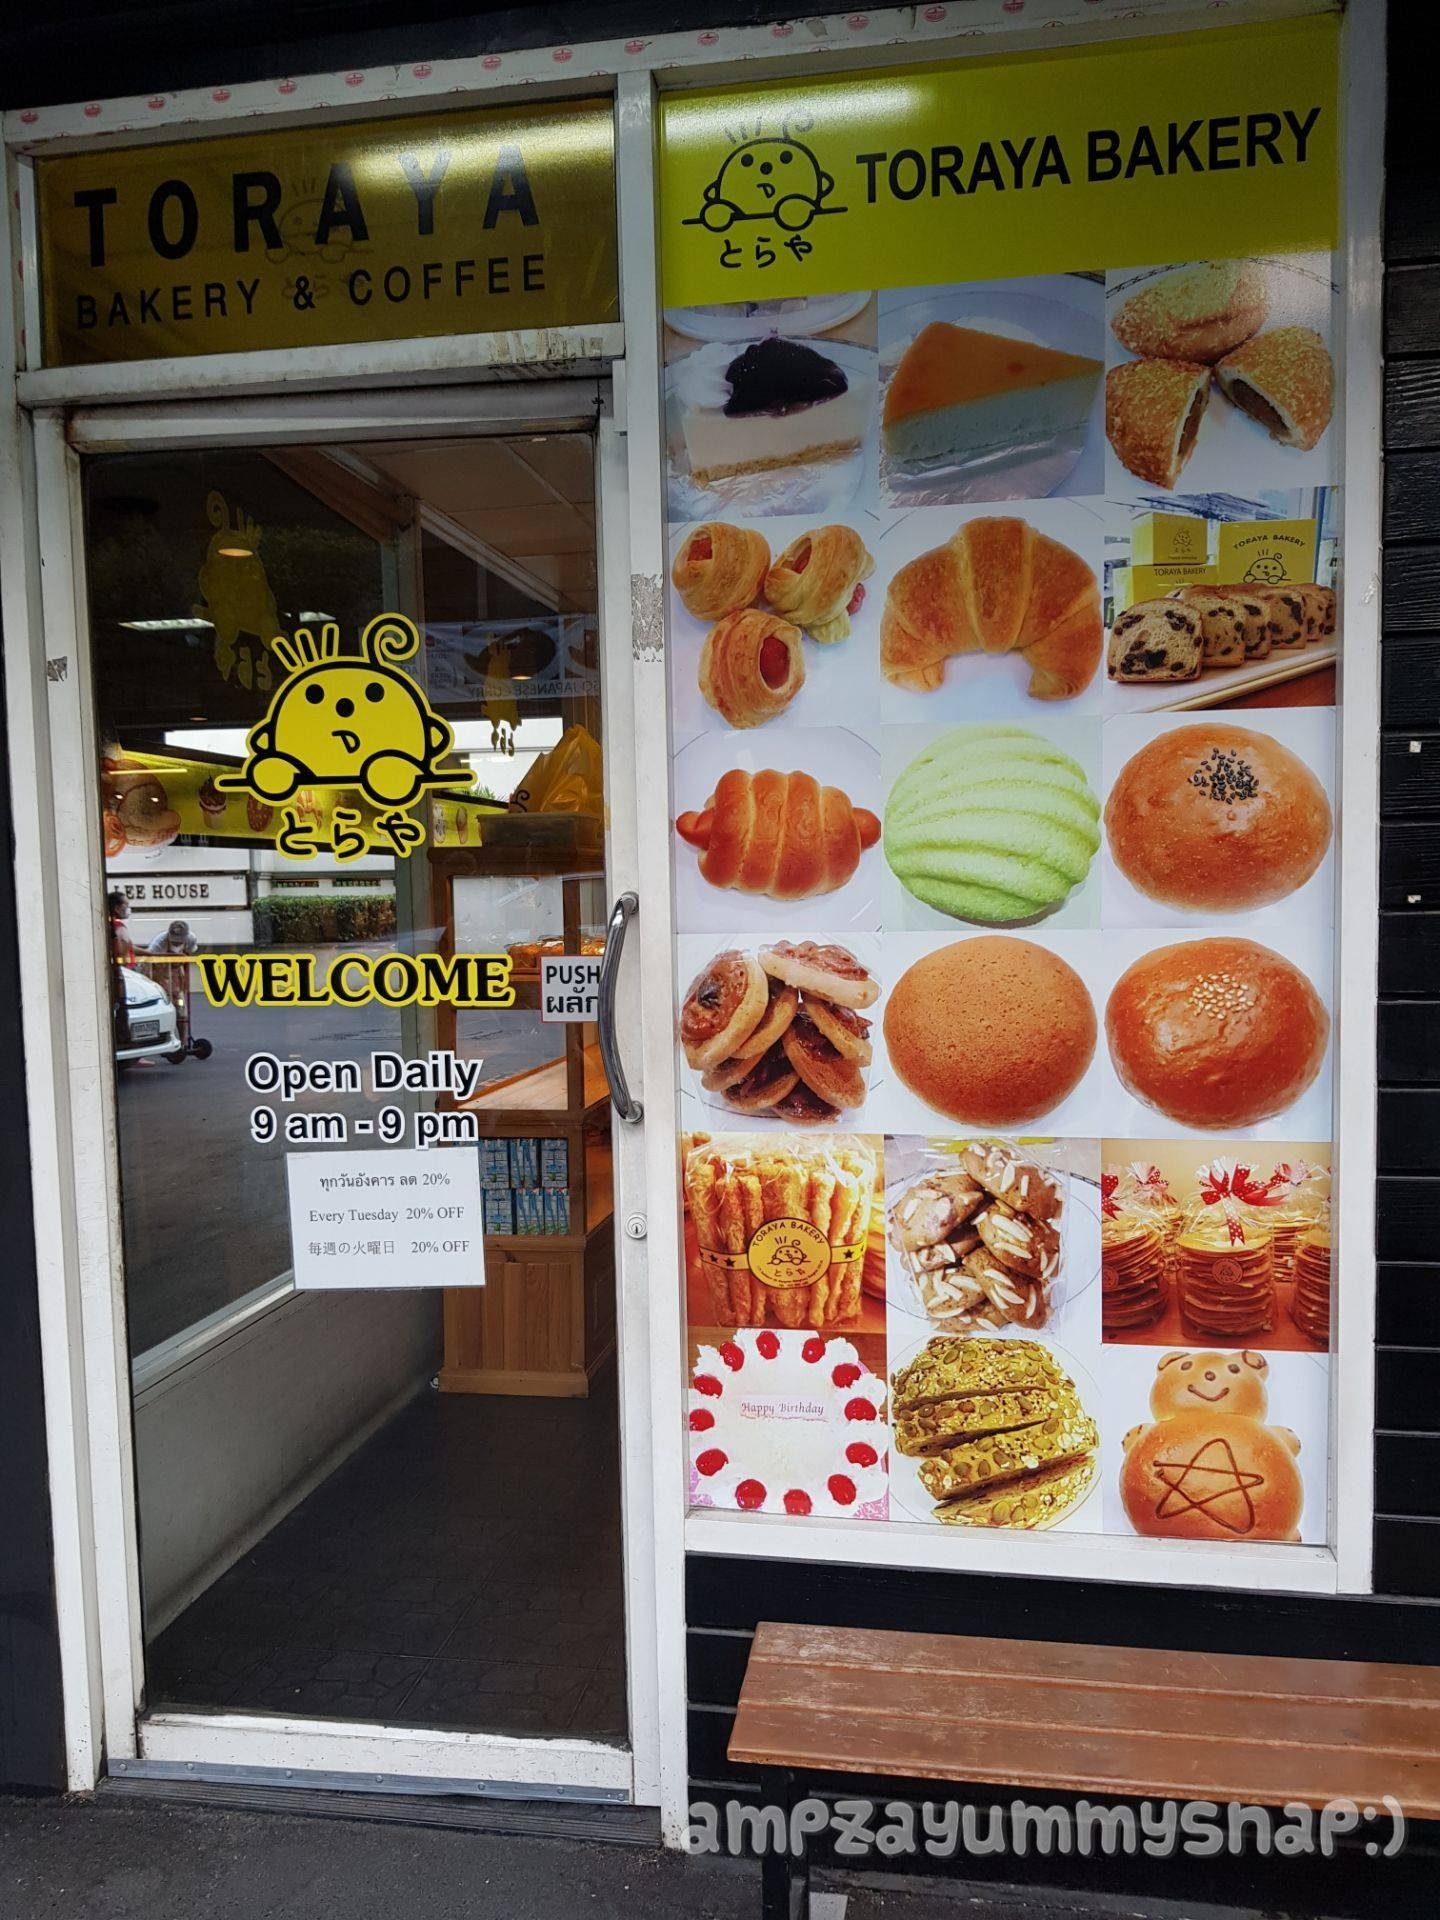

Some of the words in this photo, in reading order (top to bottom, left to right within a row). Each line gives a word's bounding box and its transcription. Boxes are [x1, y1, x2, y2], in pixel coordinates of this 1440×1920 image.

[857, 135, 1069, 203] TORAYA
[1088, 107, 1321, 182] BAKERY
[74, 145, 540, 268] TORAYA
[719, 235, 813, 269] とらや
[76, 278, 260, 330] BAKERY
[293, 276, 316, 310] &
[348, 254, 545, 305] COFFEE
[1233, 535, 1268, 550] TORAYA
[1273, 534, 1306, 548] BAKERY
[278, 811, 423, 860] とらや
[152, 883, 209, 899] HOUSE
[199, 955, 512, 1004] WELCOME
[546, 965, 600, 984] PUSH
[248, 1055, 358, 1098] Open
[374, 1053, 478, 1096] Daily
[254, 1109, 273, 1139] 9
[289, 1116, 343, 1139] am
[382, 1109, 401, 1139] 9
[417, 1113, 476, 1147] pm
[319, 1172, 395, 1192] ทุกวันอังคาร
[400, 1175, 417, 1186] ลด
[422, 1173, 451, 1186] 20%
[309, 1209, 344, 1224] Every
[348, 1208, 399, 1223] Tuesday
[406, 1207, 433, 1220] 20%
[437, 1206, 465, 1219] OFF
[411, 1241, 439, 1254] 20%
[442, 1240, 470, 1253] OFF
[752, 1221, 786, 1248] TORAYA
[790, 1220, 825, 1245] BAKERY
[741, 1402, 775, 1415] Happy
[779, 1402, 824, 1416] Birthday
